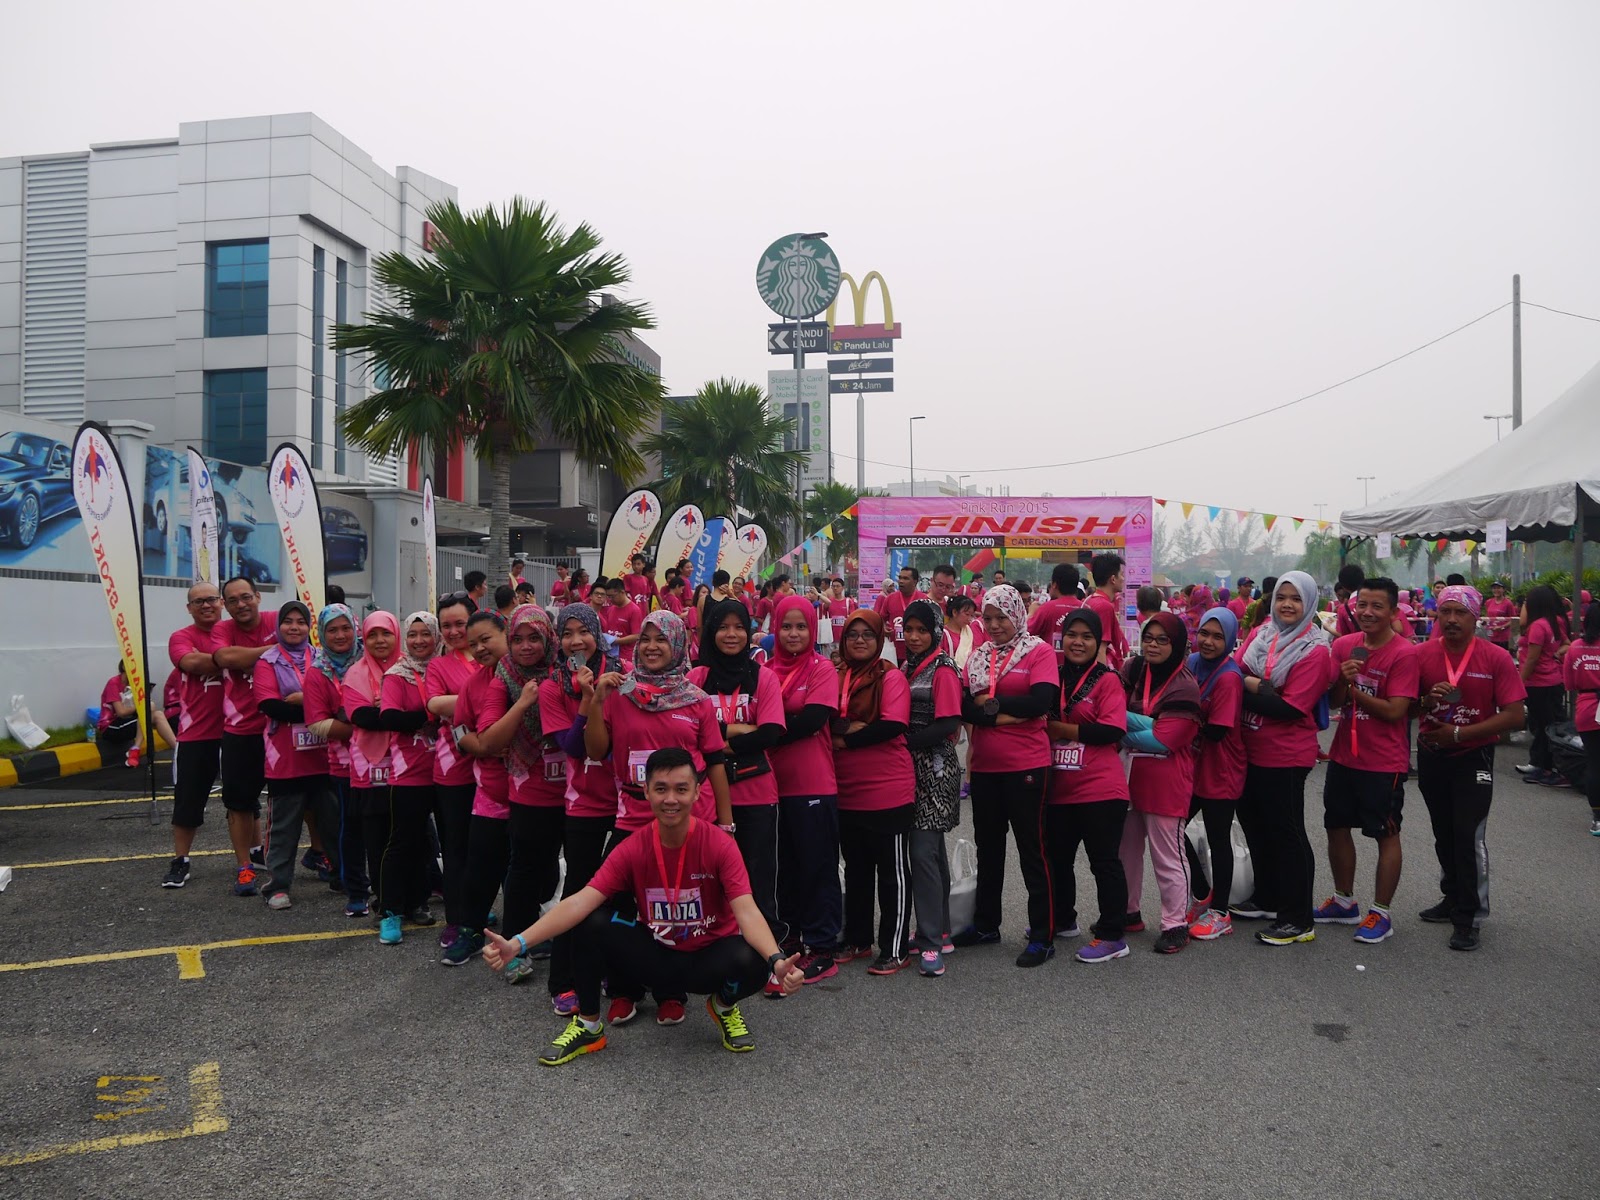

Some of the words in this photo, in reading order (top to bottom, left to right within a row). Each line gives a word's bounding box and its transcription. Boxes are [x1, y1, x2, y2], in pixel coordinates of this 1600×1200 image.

[792, 329, 823, 339] PANDU
[792, 339, 817, 348] LALU
[844, 341, 871, 350] Pandu
[872, 340, 890, 349] Lalu
[771, 376, 804, 384] Starbucs
[852, 382, 864, 390] 24
[864, 381, 882, 390] Jam
[961, 502, 986, 513] Pink
[990, 502, 1014, 513] Run
[1019, 502, 1049, 513] 2015
[912, 515, 1127, 534] FINISH
[894, 537, 951, 546] CATEGORIES
[953, 537, 968, 547] C,D
[970, 537, 995, 547] (5KM)
[1011, 538, 1068, 546] CATEGORIES
[1091, 538, 1116, 547] (7KM)
[1584, 663, 1600, 671] 2015
[654, 902, 698, 920] A1074
